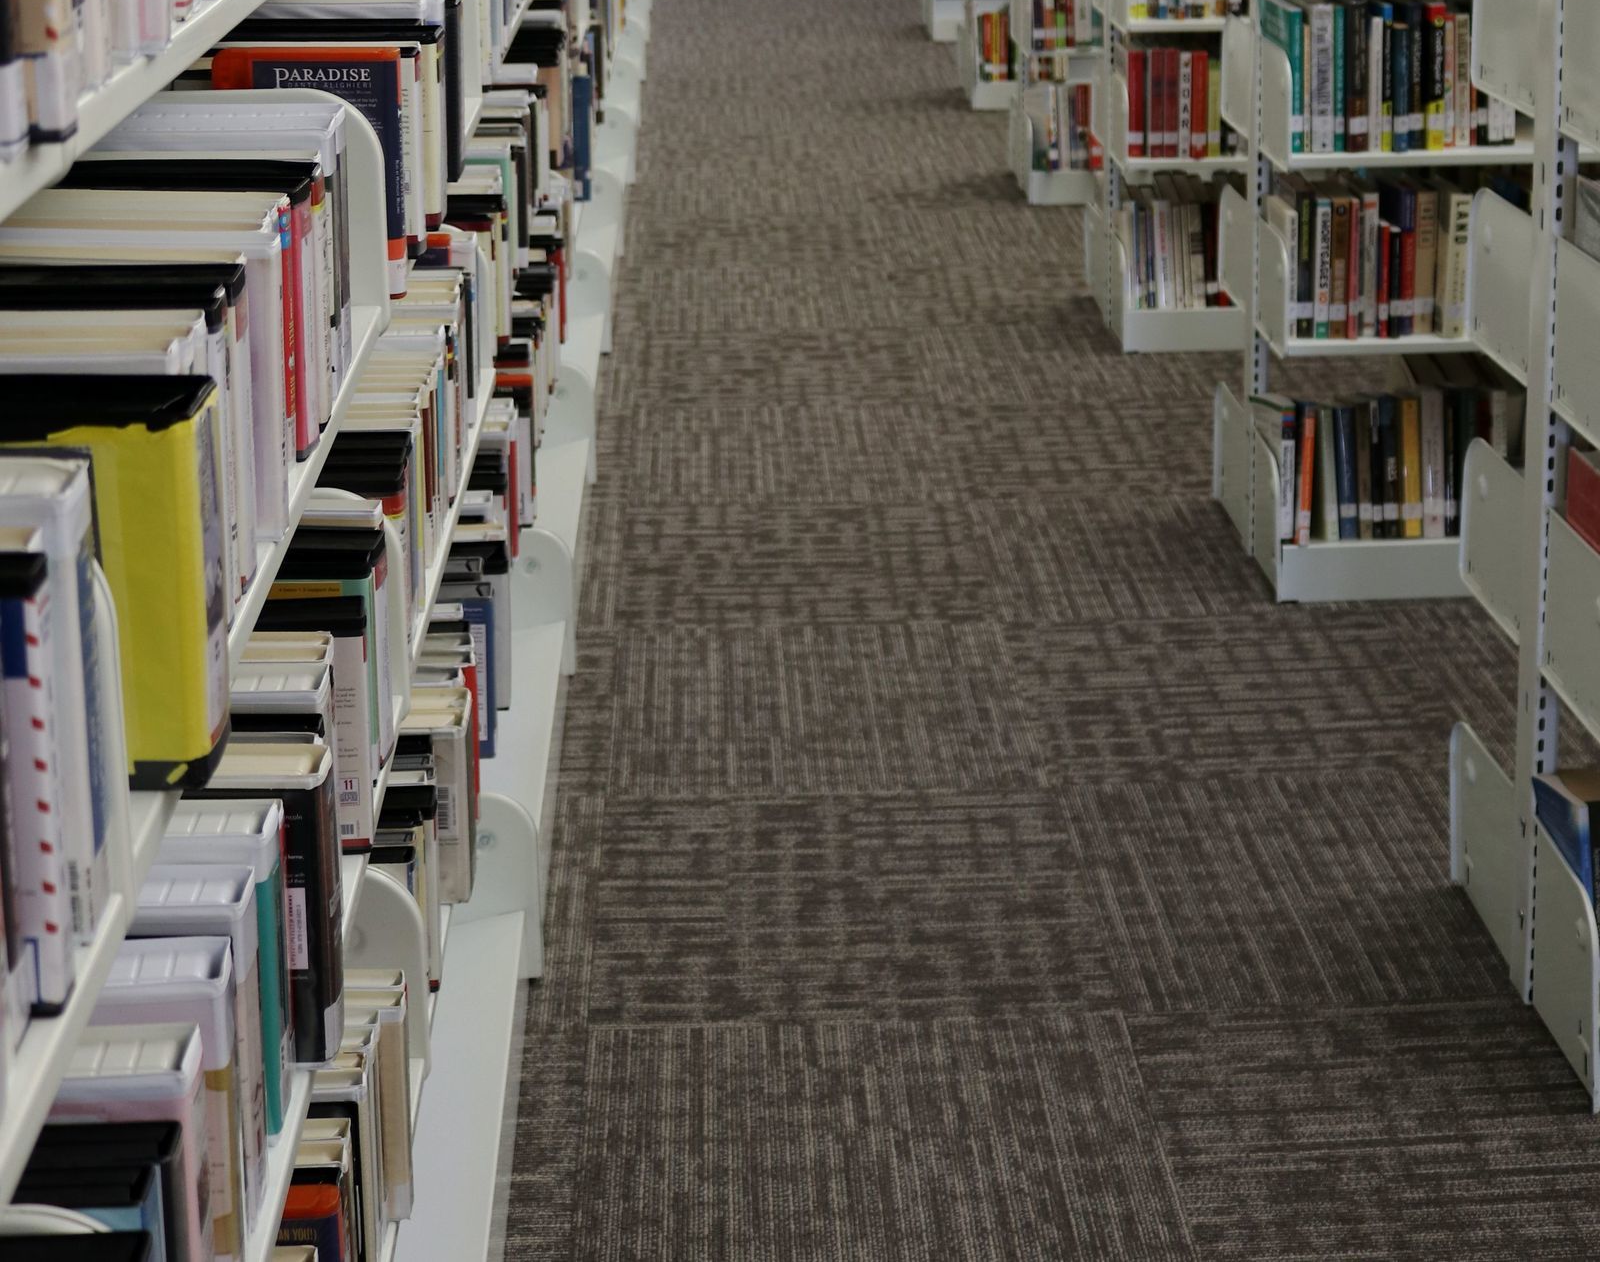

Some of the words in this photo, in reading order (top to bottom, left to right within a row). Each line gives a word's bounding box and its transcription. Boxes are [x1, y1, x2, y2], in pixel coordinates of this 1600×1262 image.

[273, 67, 372, 88] PARADISE
[1456, 200, 1469, 244] LAND
[343, 779, 353, 790] 11
